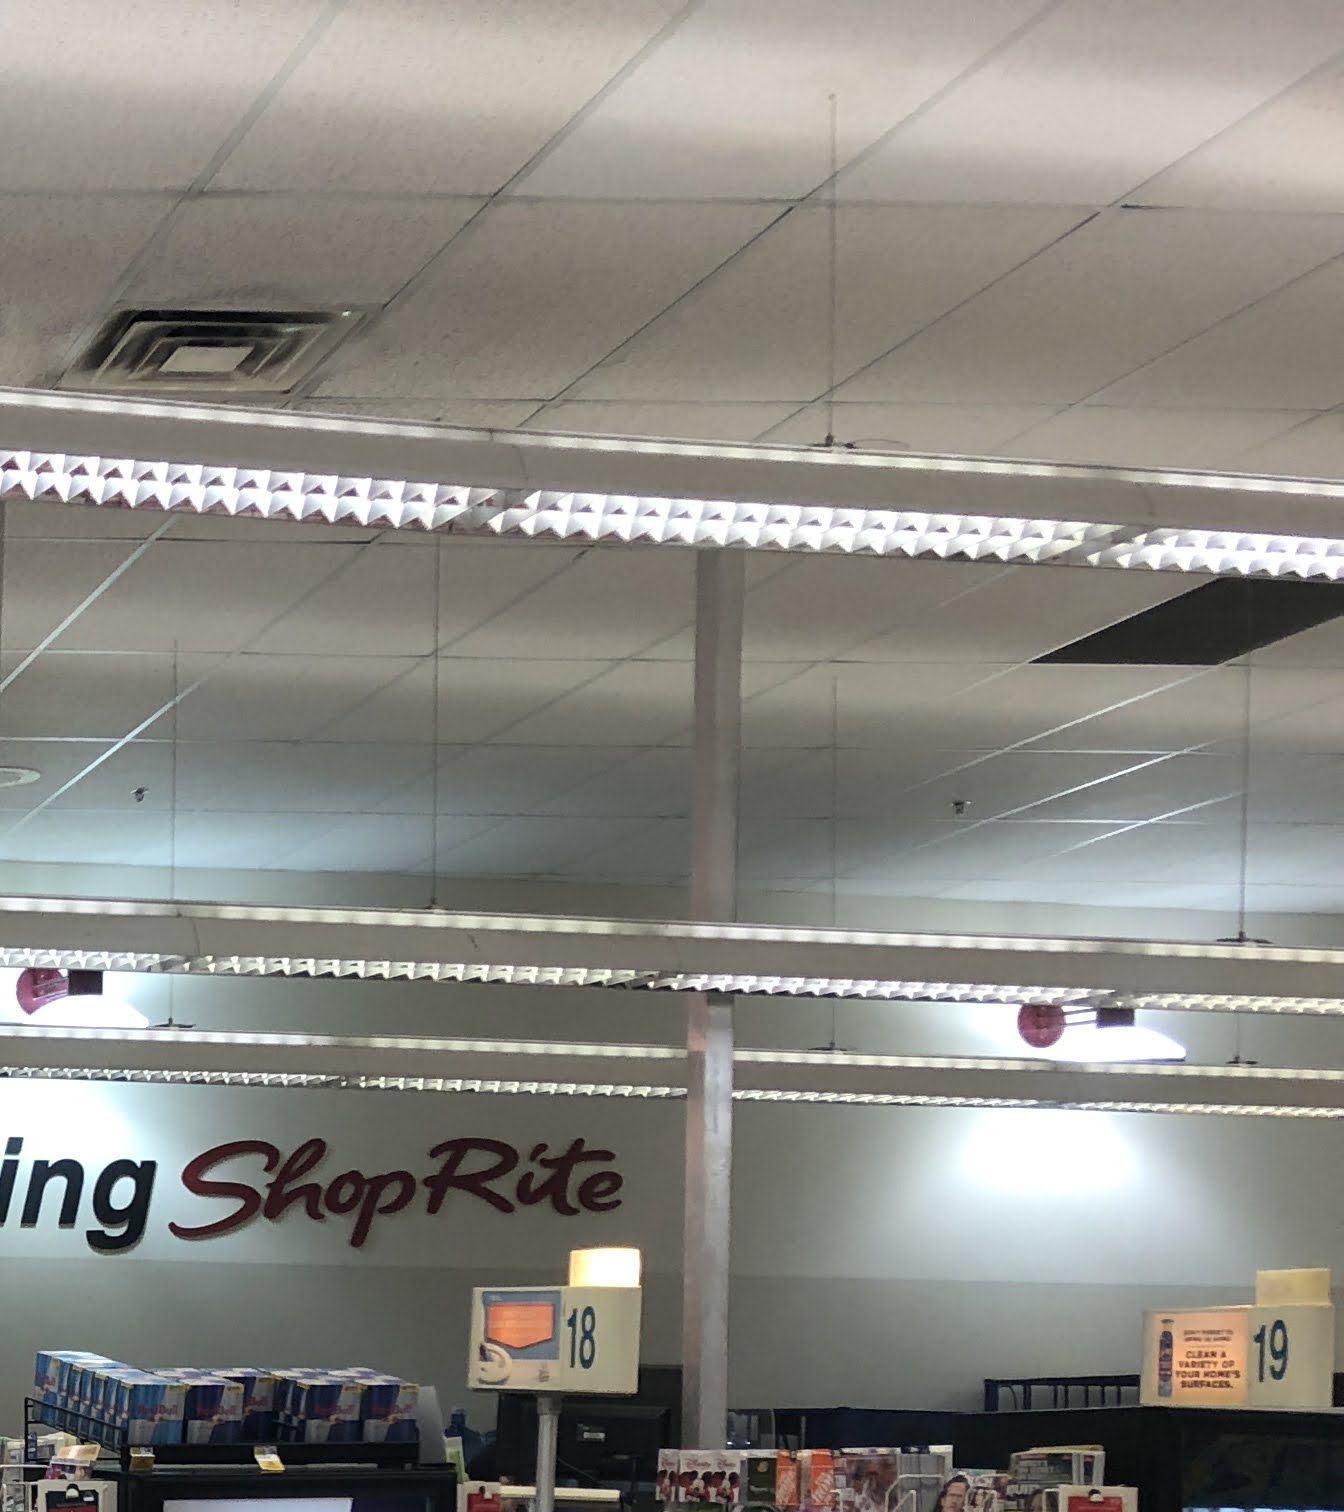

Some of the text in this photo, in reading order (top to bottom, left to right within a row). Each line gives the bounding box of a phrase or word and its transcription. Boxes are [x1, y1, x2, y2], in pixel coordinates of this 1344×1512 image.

[167, 1136, 624, 1248] ShopRite
[567, 1305, 596, 1370] 18
[1186, 1350, 1217, 1358] CLEAN
[1253, 1319, 1289, 1383] 19
[1175, 1370, 1200, 1378] YOUR
